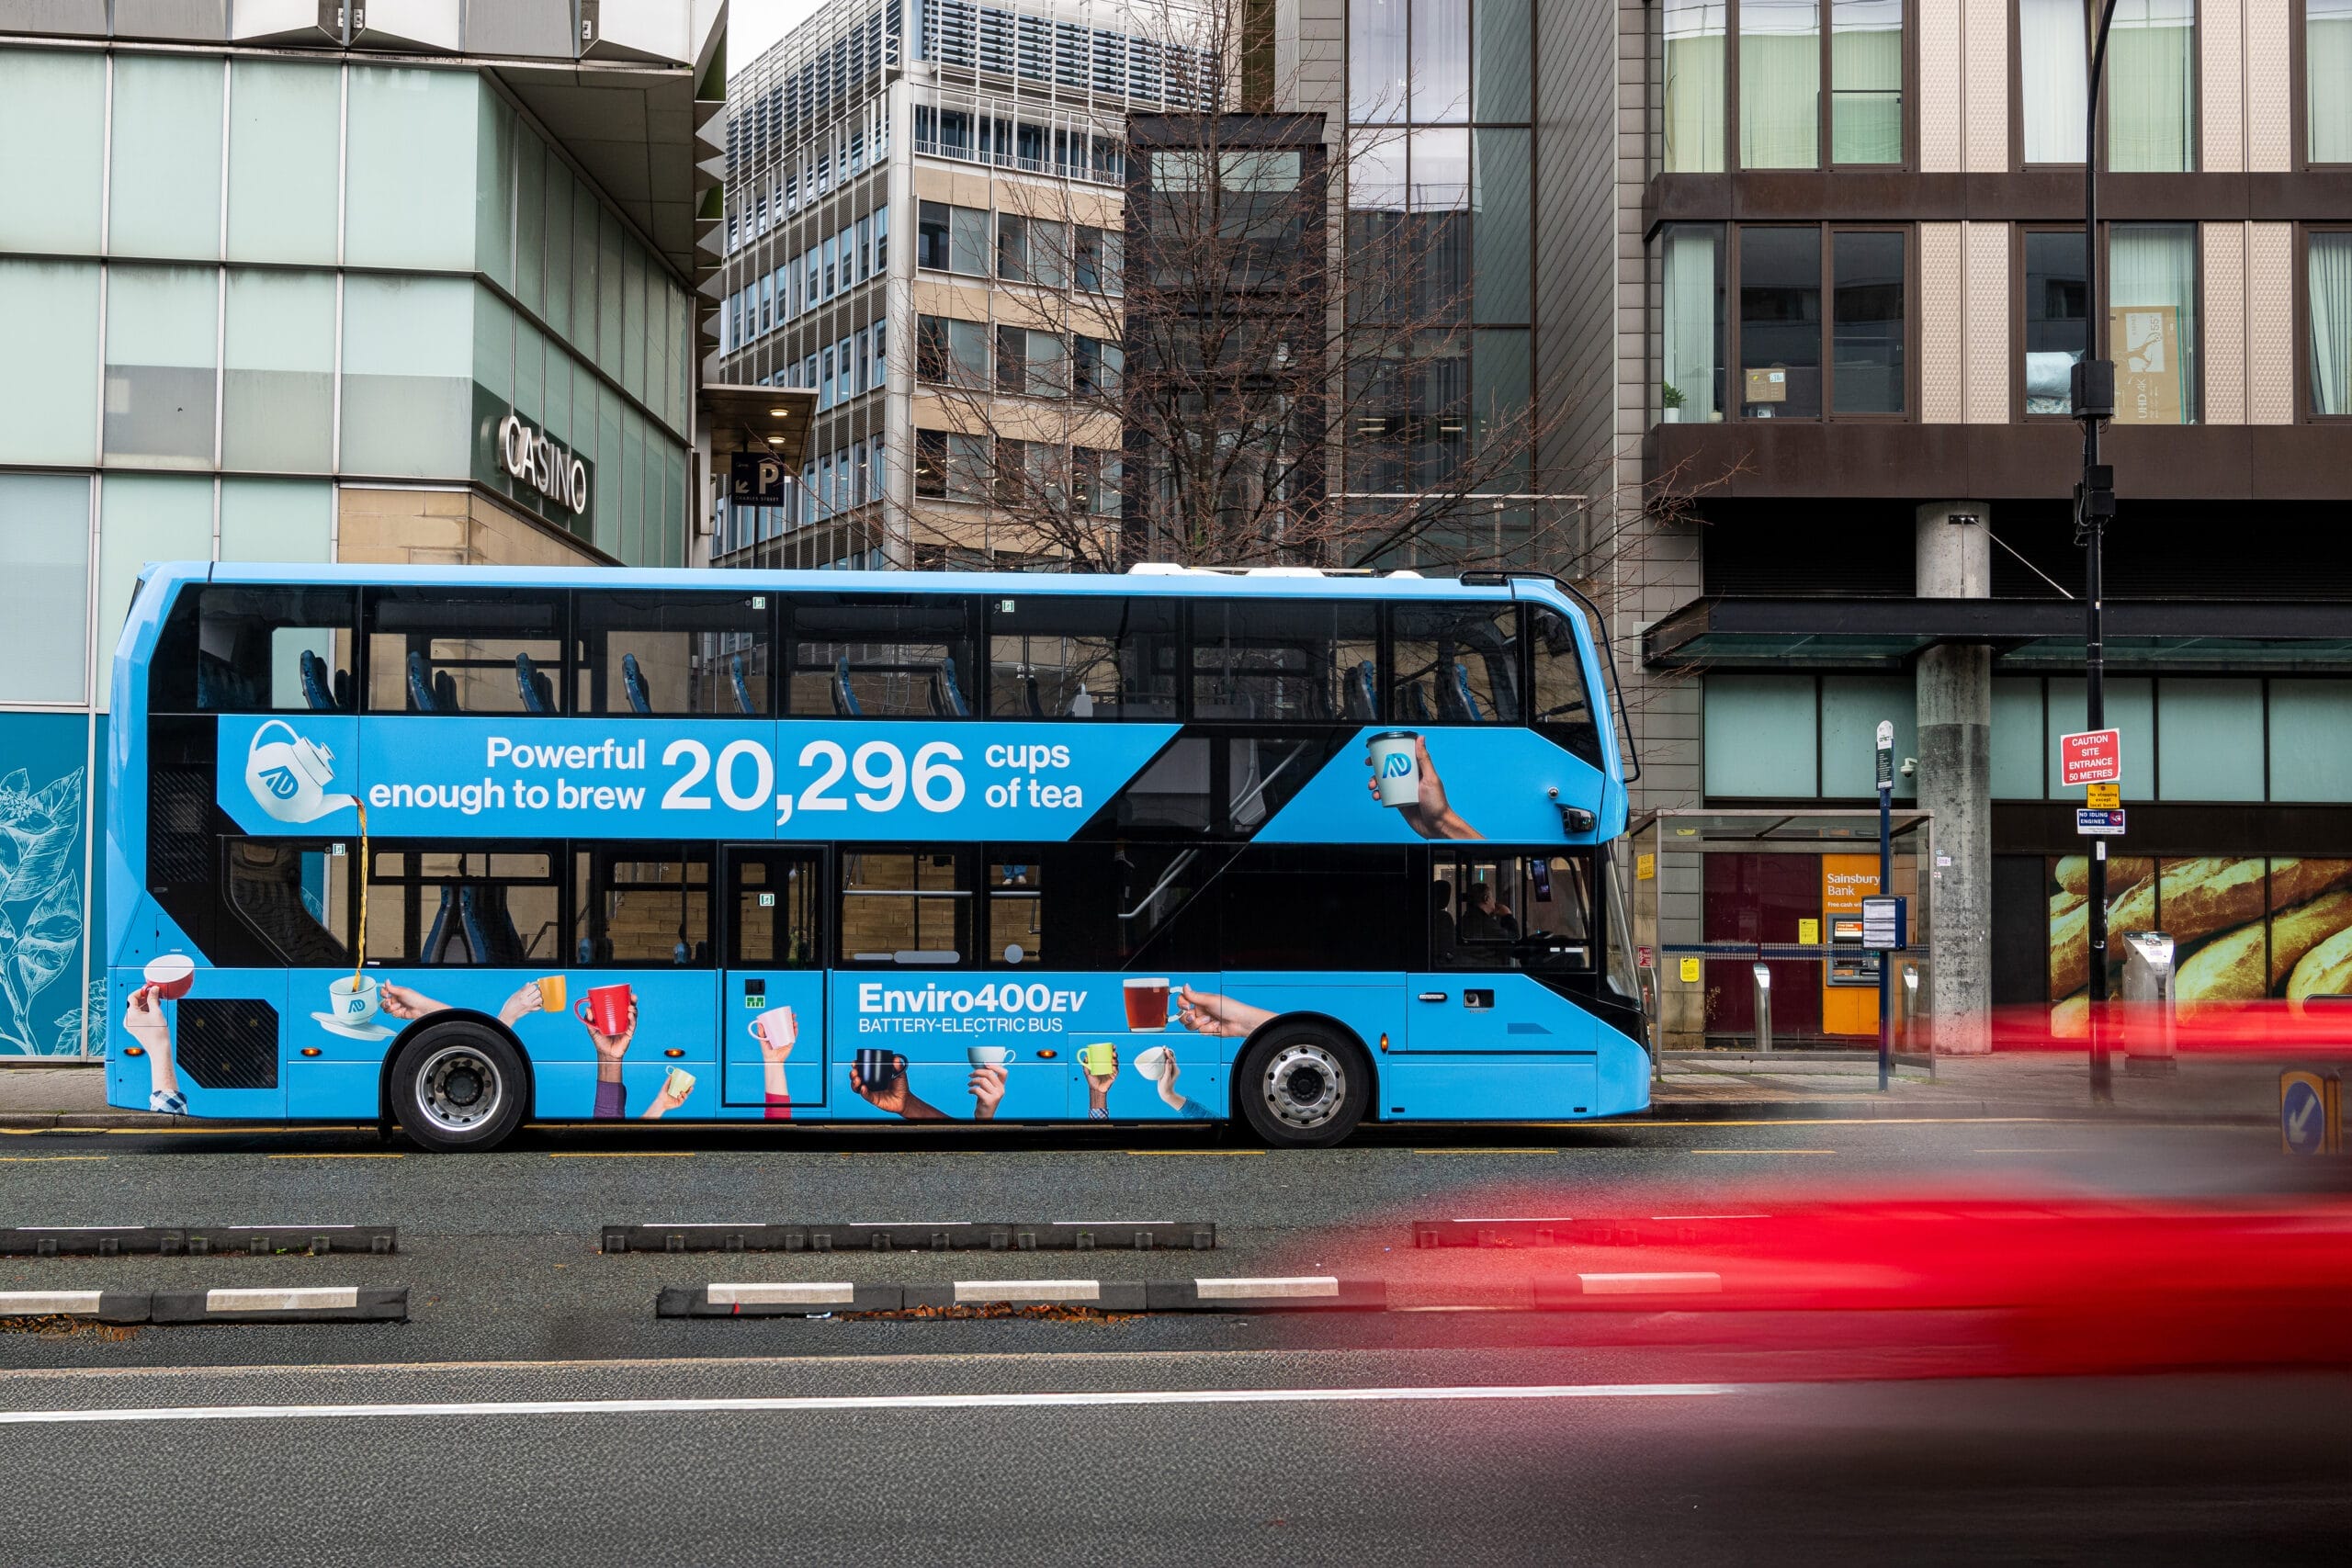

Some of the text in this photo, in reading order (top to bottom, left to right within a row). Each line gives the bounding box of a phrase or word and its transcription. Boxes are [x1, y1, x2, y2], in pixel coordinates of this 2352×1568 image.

[2137, 378, 2147, 419] UHD 4K
[503, 415, 586, 514] CASINO
[759, 462, 779, 494] P
[488, 737, 645, 770] Powerful
[2072, 735, 2109, 747] CAUTION
[2081, 748, 2099, 757] SITE
[985, 745, 1069, 773] cups
[2069, 757, 2113, 770] ENTRANCE
[662, 739, 966, 826] 20,296
[2069, 769, 2113, 781] 50 METRES
[369, 777, 645, 815] enough to brew
[985, 777, 1082, 808] of tea
[1827, 873, 1881, 886] Sainsbury
[1827, 885, 1855, 896] Bank
[859, 983, 1088, 1012] Enviro400EV
[859, 1018, 1063, 1032] BATTERY-ELECTRIC BUS
